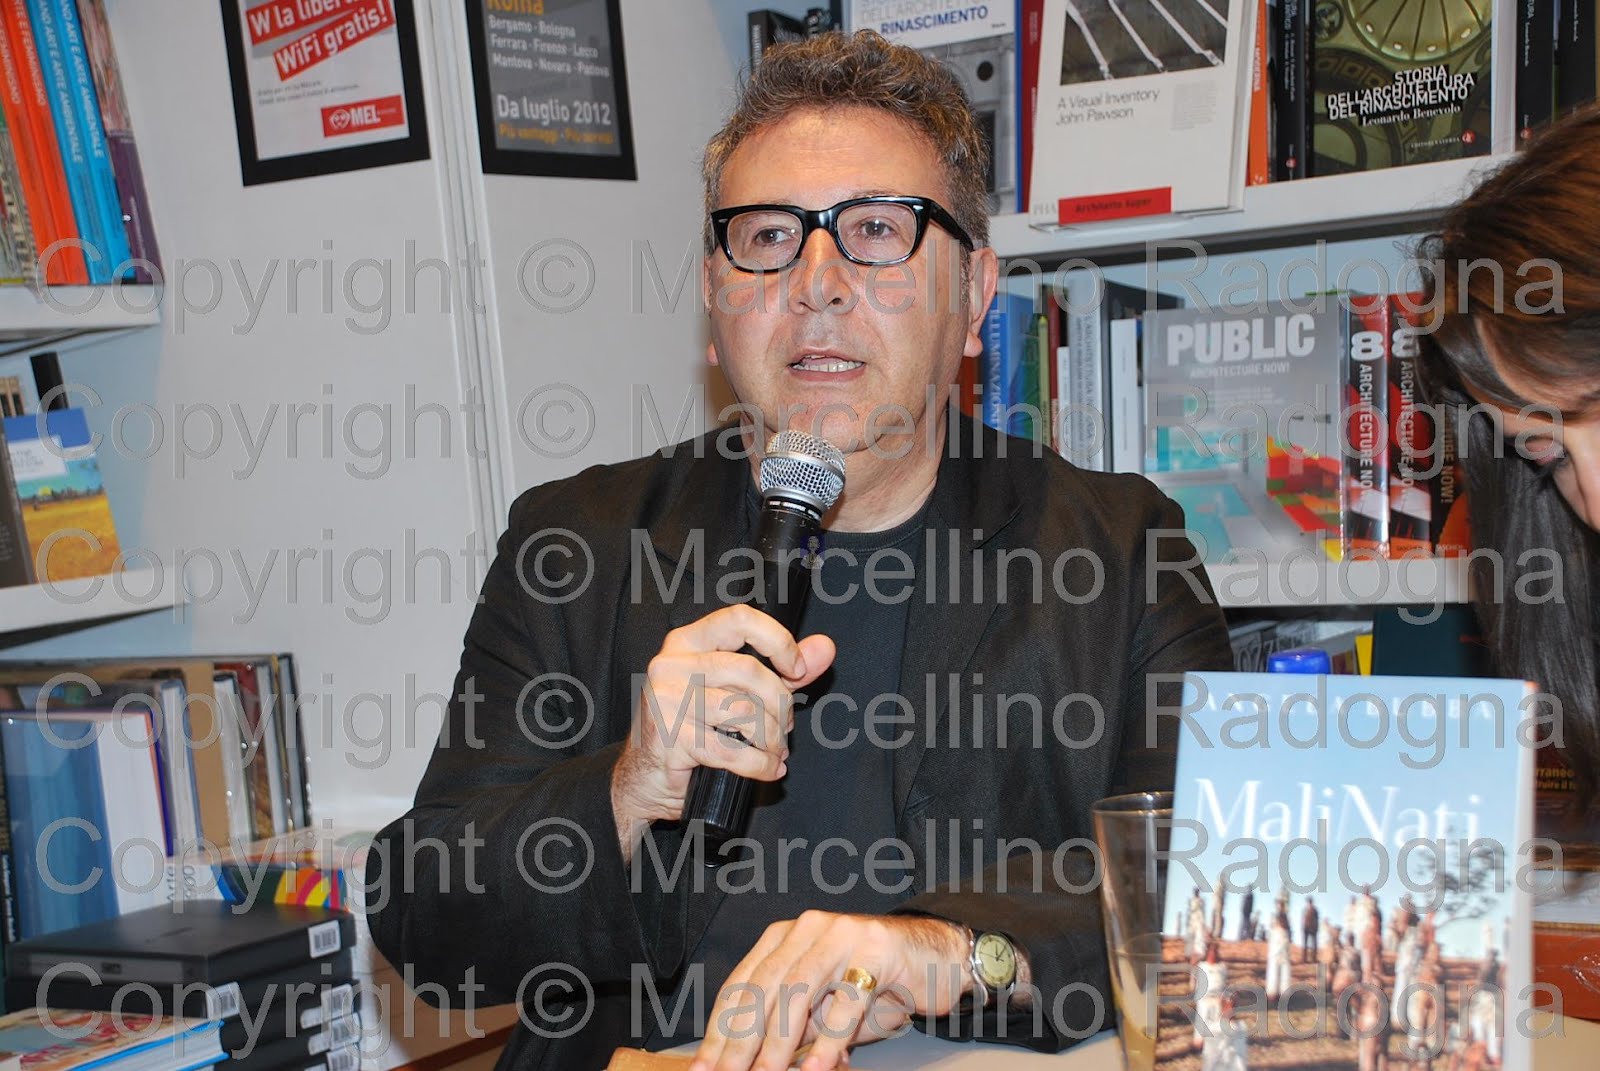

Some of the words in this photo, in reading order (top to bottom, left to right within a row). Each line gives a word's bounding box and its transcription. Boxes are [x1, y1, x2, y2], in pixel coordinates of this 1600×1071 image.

[251, 8, 271, 37] W
[274, 6, 295, 29] la
[488, 14, 533, 33] Bergamo
[538, 20, 576, 39] Bologna
[880, 6, 988, 35] RINASCIMENTO
[276, 33, 322, 74] WiFi
[324, 0, 388, 57] gratis!
[490, 33, 528, 50] Ferrara
[533, 38, 567, 55] Firenze
[493, 52, 533, 69] Mantova
[1394, 64, 1448, 86] STORIA
[1057, 98, 1067, 109] A
[1068, 94, 1103, 109] Visual
[1104, 88, 1160, 104] Inventory
[1328, 73, 1475, 109] DELL'ARCHITETTURA
[1329, 105, 1357, 121] DEL
[1359, 86, 1468, 115] RINASCIMENTO
[350, 104, 381, 126] MEL
[497, 93, 520, 119] Da
[523, 96, 570, 126] luglio
[573, 100, 611, 125] 2012
[1055, 110, 1085, 126] John
[1086, 107, 1134, 122] Pawson
[1362, 110, 1411, 127] Leonardo
[1413, 104, 1461, 120] Benevolo
[1167, 313, 1315, 366] PUBLIC
[1350, 330, 1384, 361] 8
[1263, 361, 1290, 374] NOW!
[1359, 363, 1373, 467] ARCHITECTURE
[1400, 361, 1414, 468] ARCHITECTURE
